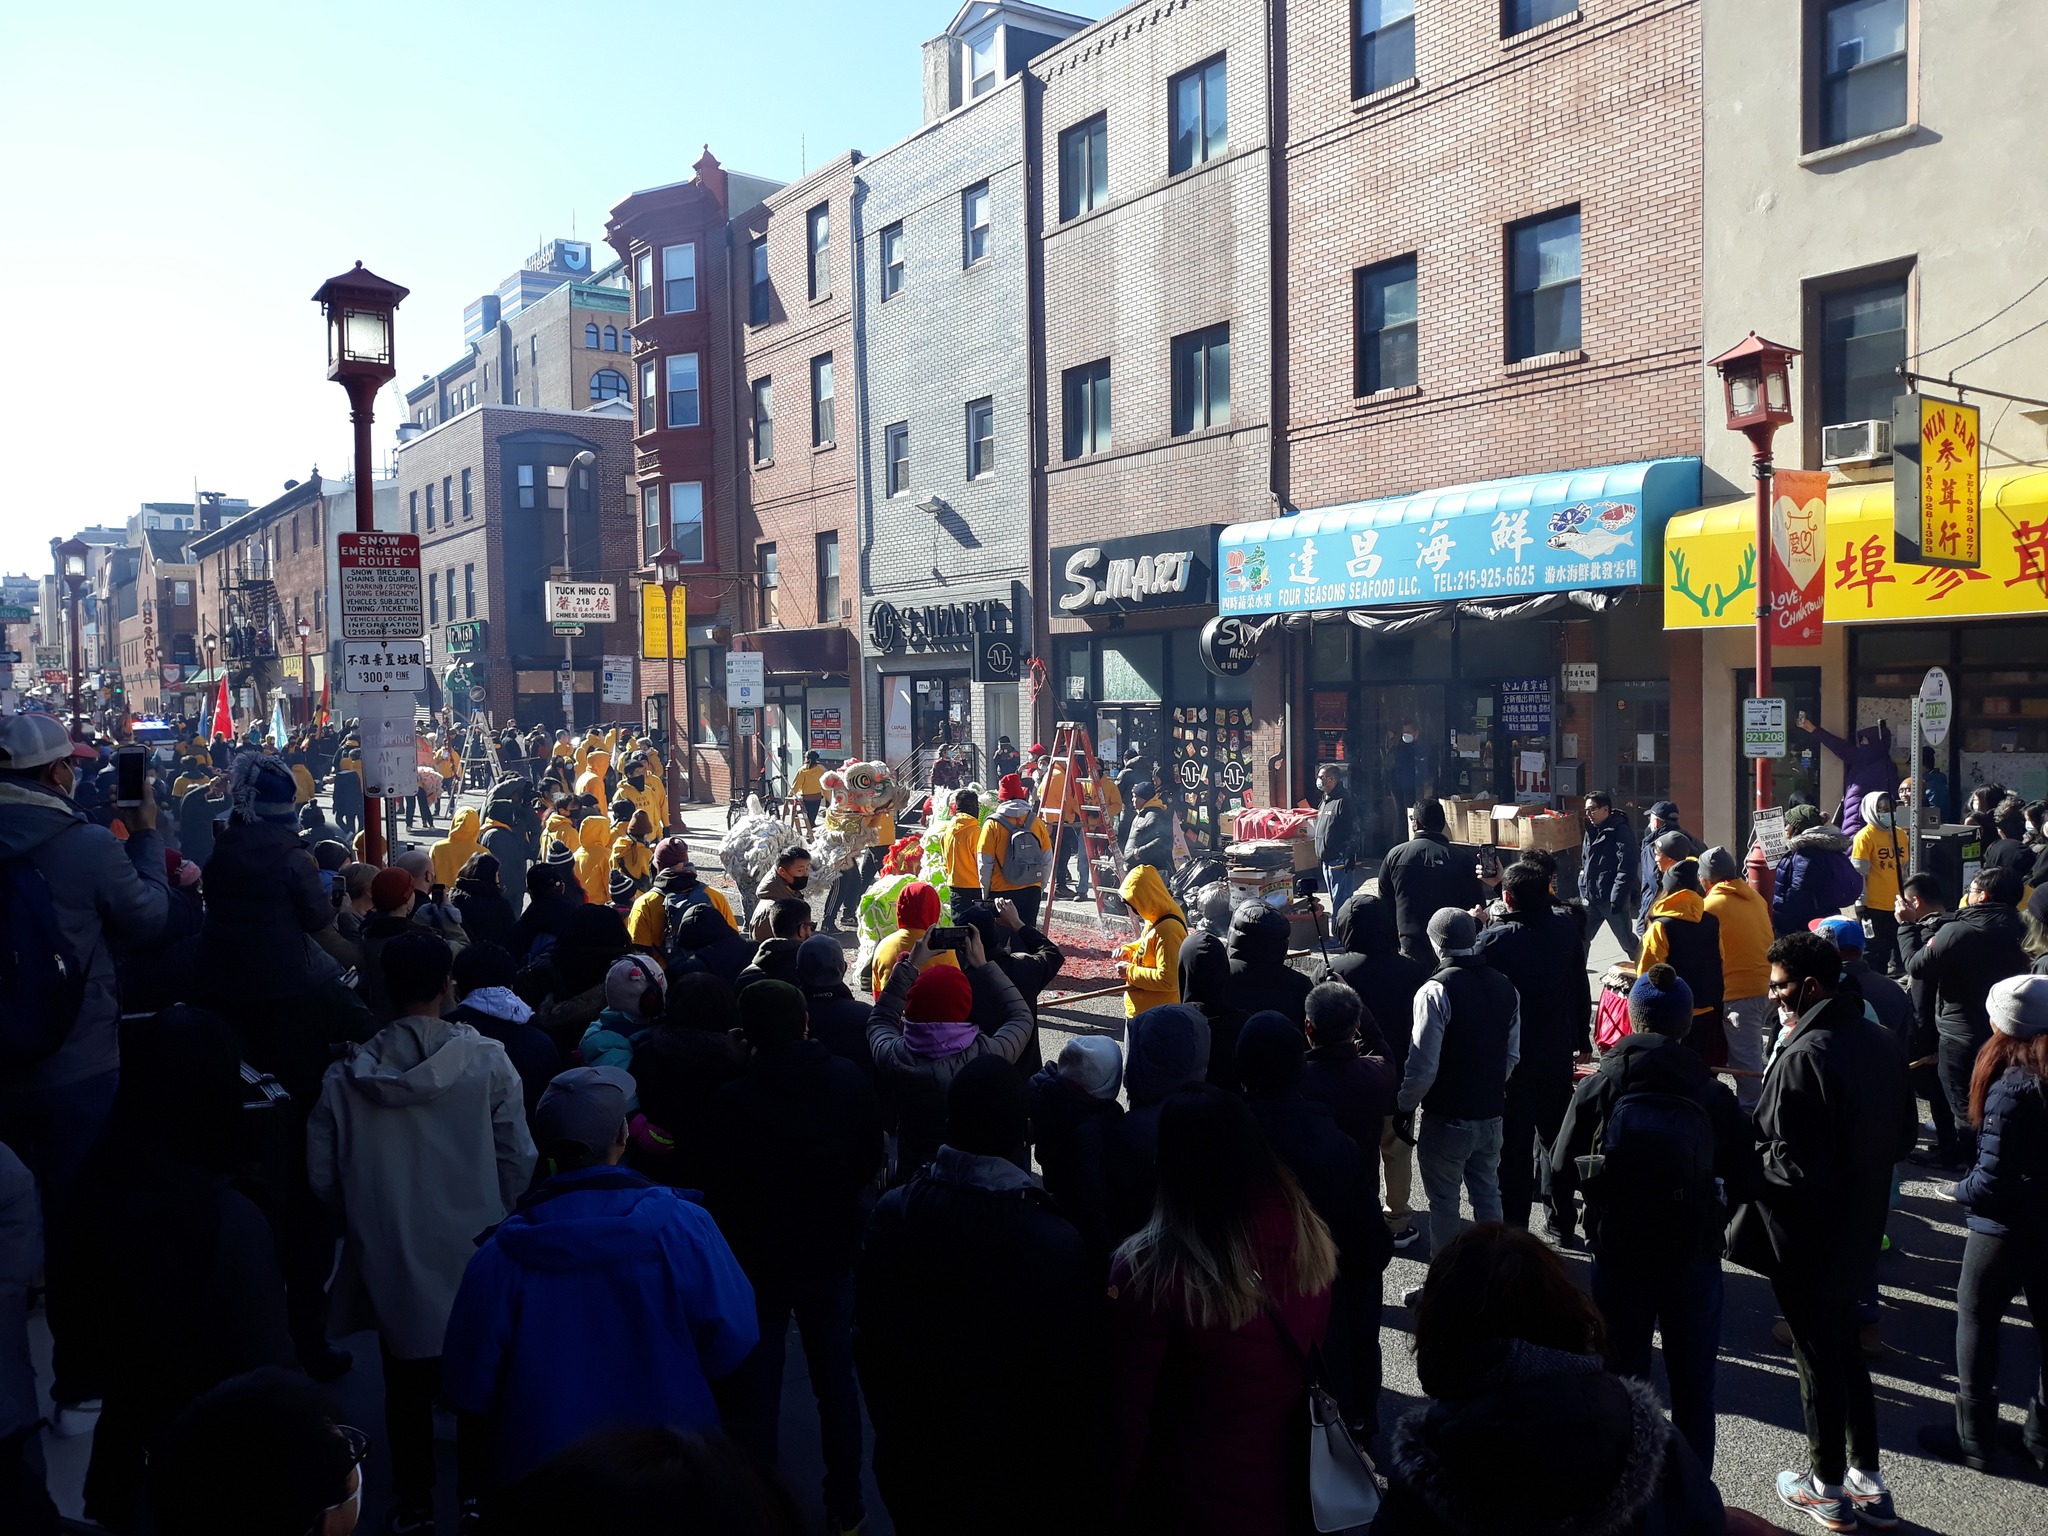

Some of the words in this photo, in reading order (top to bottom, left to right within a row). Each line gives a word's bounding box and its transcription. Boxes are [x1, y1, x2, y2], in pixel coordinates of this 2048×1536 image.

[1923, 409, 1946, 445] WIN
[1953, 412, 1976, 457] FAR
[359, 536, 399, 545] SNOW
[341, 547, 416, 556] EMERGENCY
[1288, 509, 1534, 585] 達昌海鮮
[359, 557, 400, 566] ROUTE
[1059, 547, 1194, 610] S.MART
[555, 586, 576, 595] TUCK
[578, 587, 596, 596] HING
[598, 588, 611, 596] CO.
[1278, 589, 1301, 607] FOUR
[1304, 584, 1346, 605] SEASONS
[1349, 578, 1395, 600] SEAFOOD
[396, 671, 410, 680] FINE
[367, 733, 411, 745] STOPPING
[1746, 732, 1784, 742] 921208
[1765, 839, 1782, 848] POLICE
